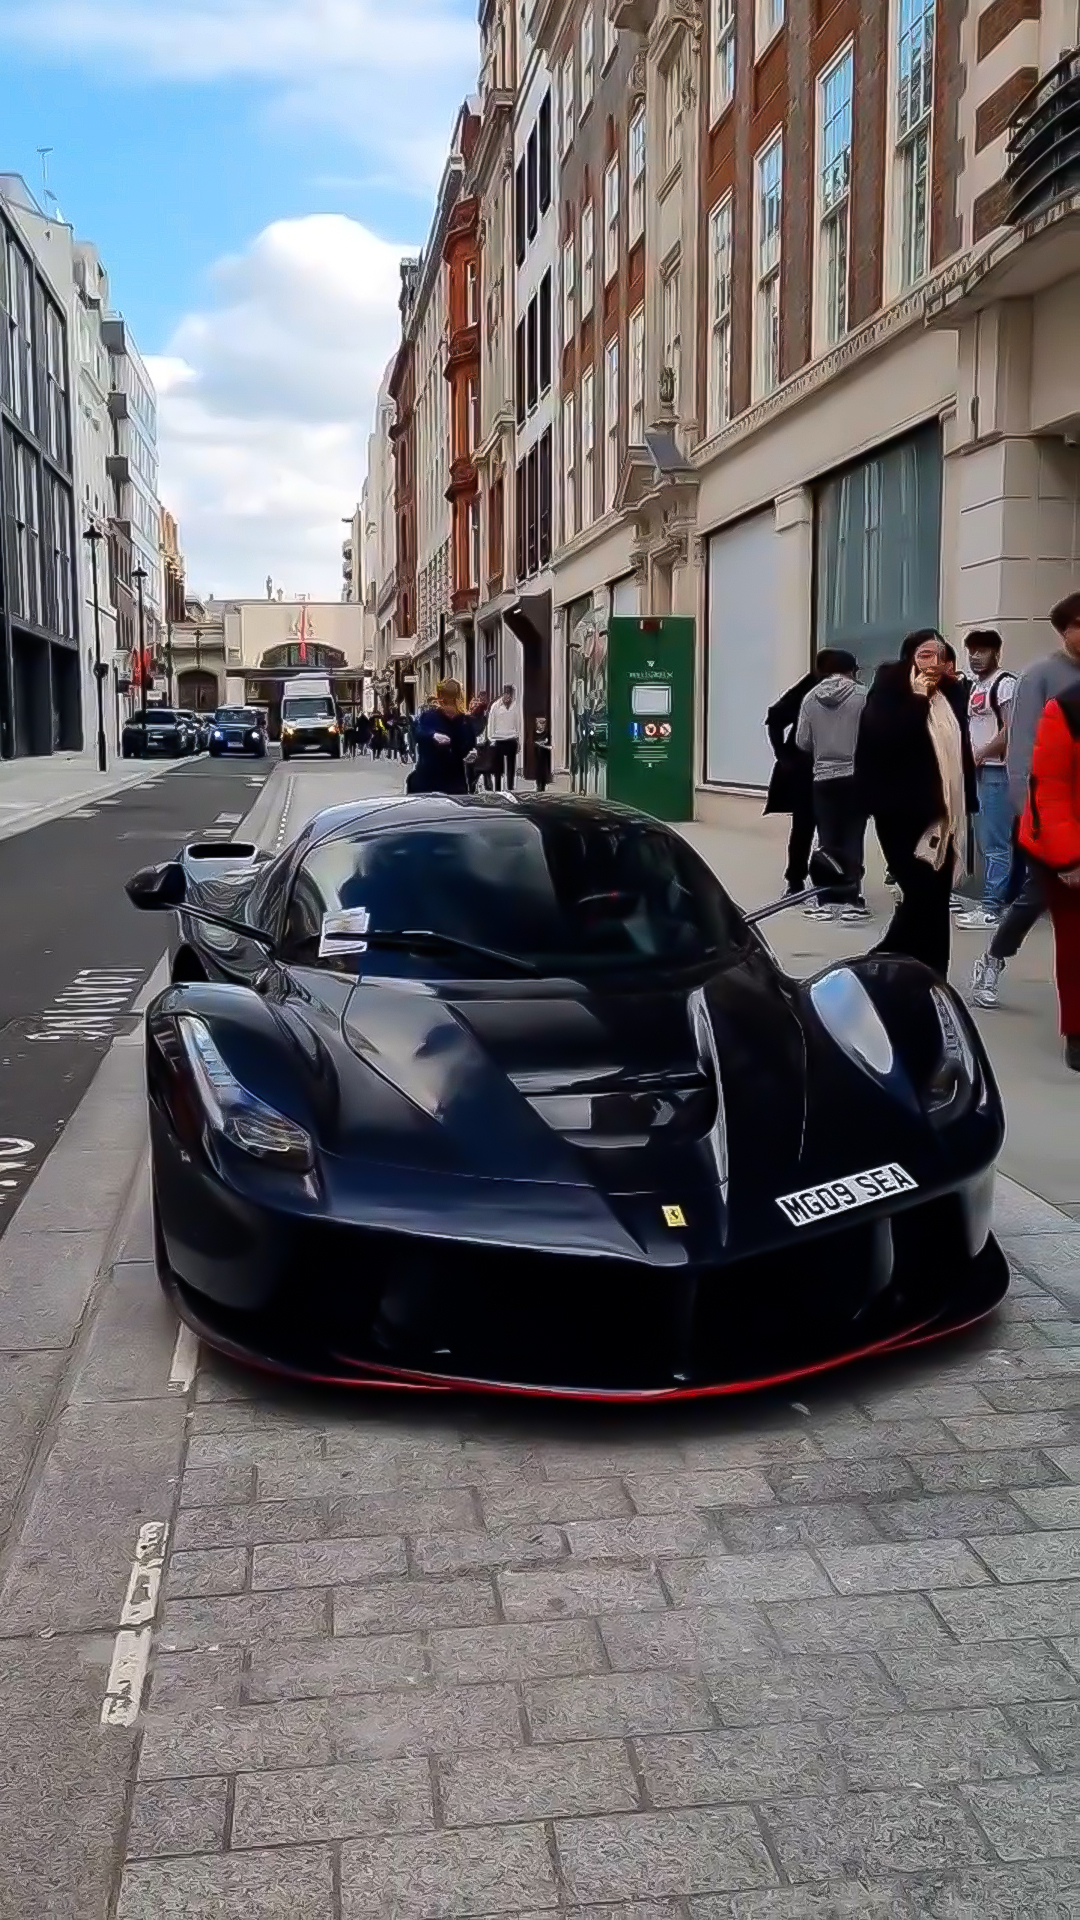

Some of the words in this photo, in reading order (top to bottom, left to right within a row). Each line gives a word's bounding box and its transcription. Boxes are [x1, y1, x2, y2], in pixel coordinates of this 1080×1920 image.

[25, 968, 145, 1040] LOADING
[780, 1182, 857, 1223] MG09
[855, 1166, 915, 1197] SEA
